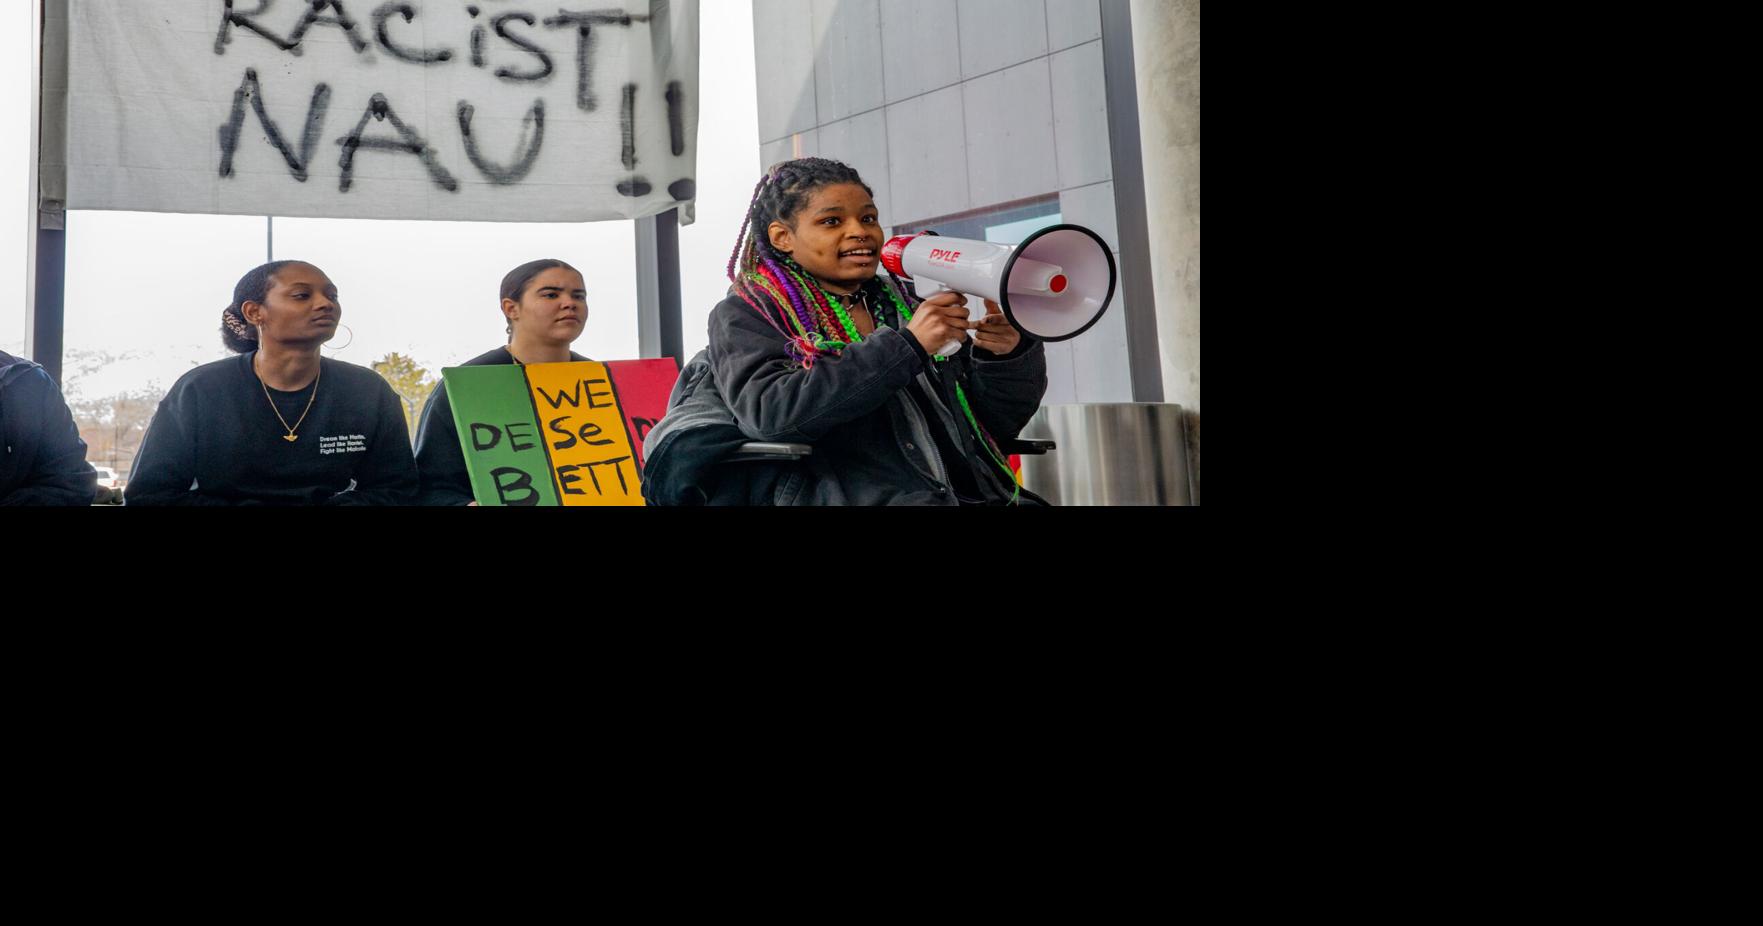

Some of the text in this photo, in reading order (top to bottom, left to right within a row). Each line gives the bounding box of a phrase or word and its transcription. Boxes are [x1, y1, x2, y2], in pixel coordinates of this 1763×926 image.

[217, 67, 545, 192] NAU
[930, 248, 961, 262] PYLE
[536, 378, 613, 410] WE
